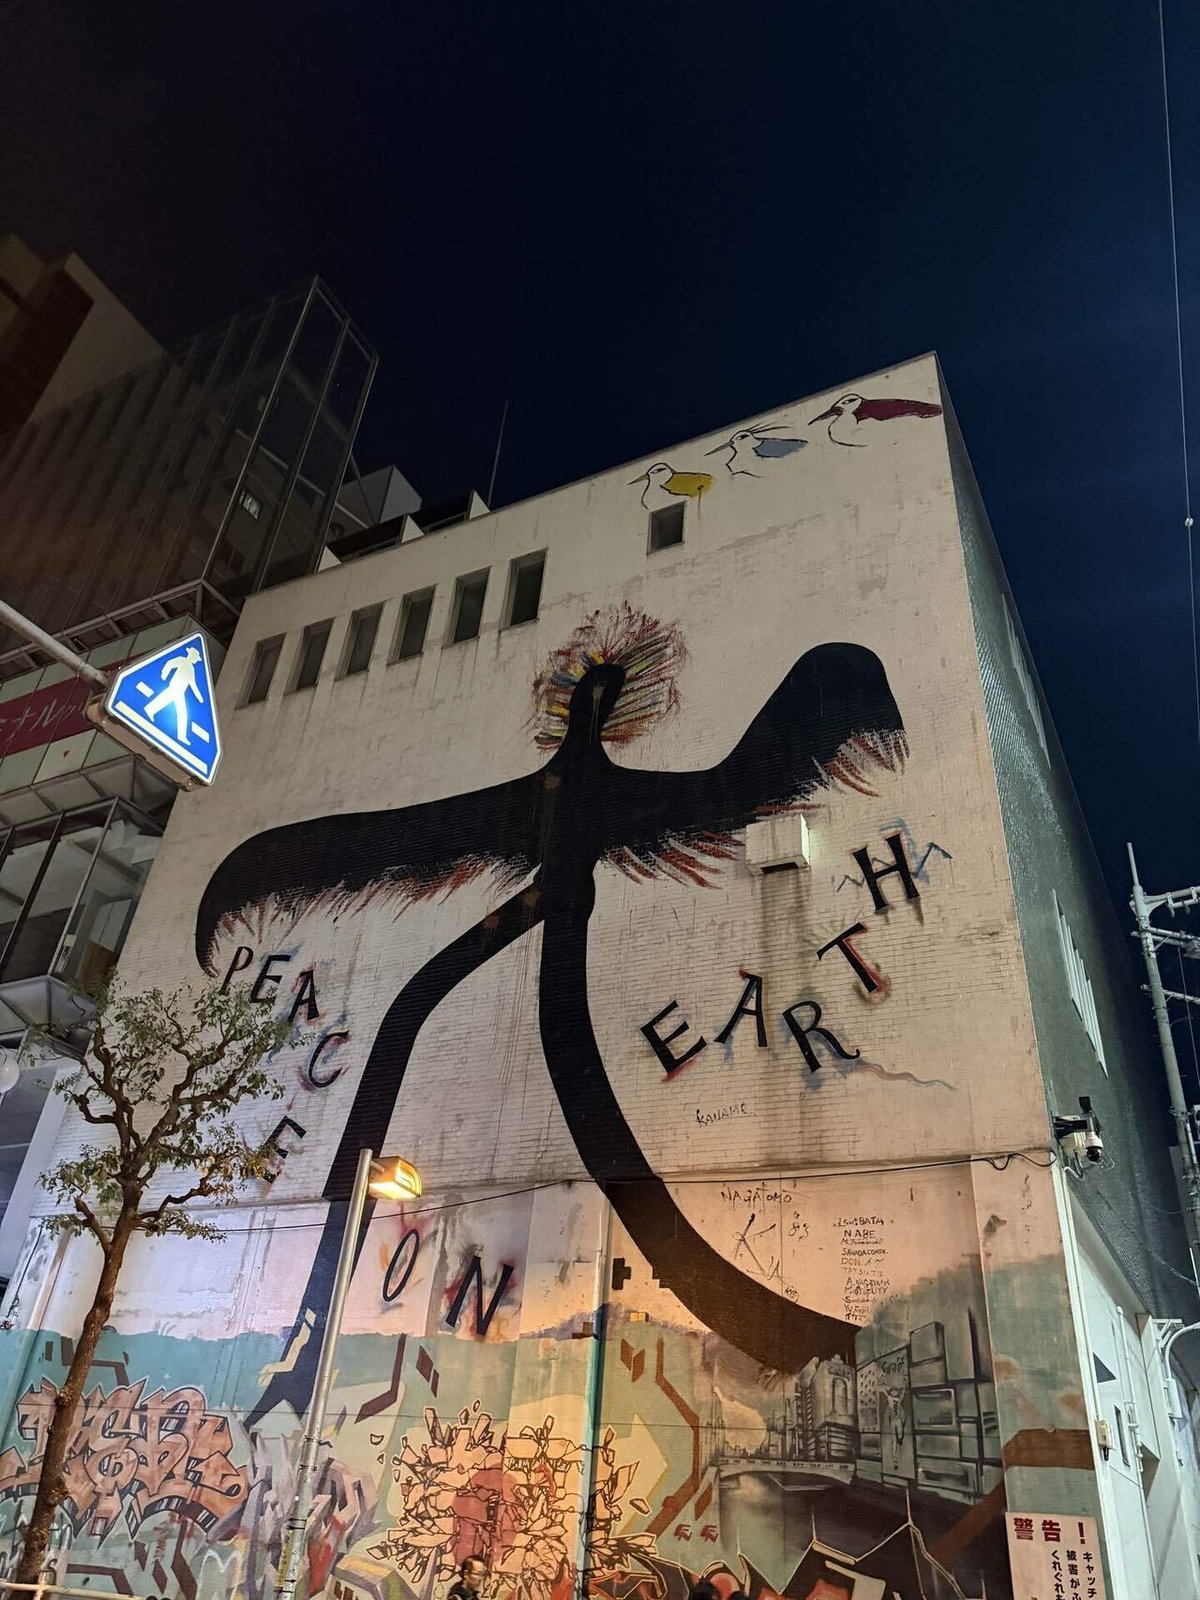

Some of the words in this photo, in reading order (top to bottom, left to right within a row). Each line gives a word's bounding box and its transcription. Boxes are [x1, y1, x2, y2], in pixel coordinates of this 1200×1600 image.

[218, 946, 352, 1182] PEACE
[640, 832, 920, 1073] EARTH
[383, 1229, 515, 1336] ON
